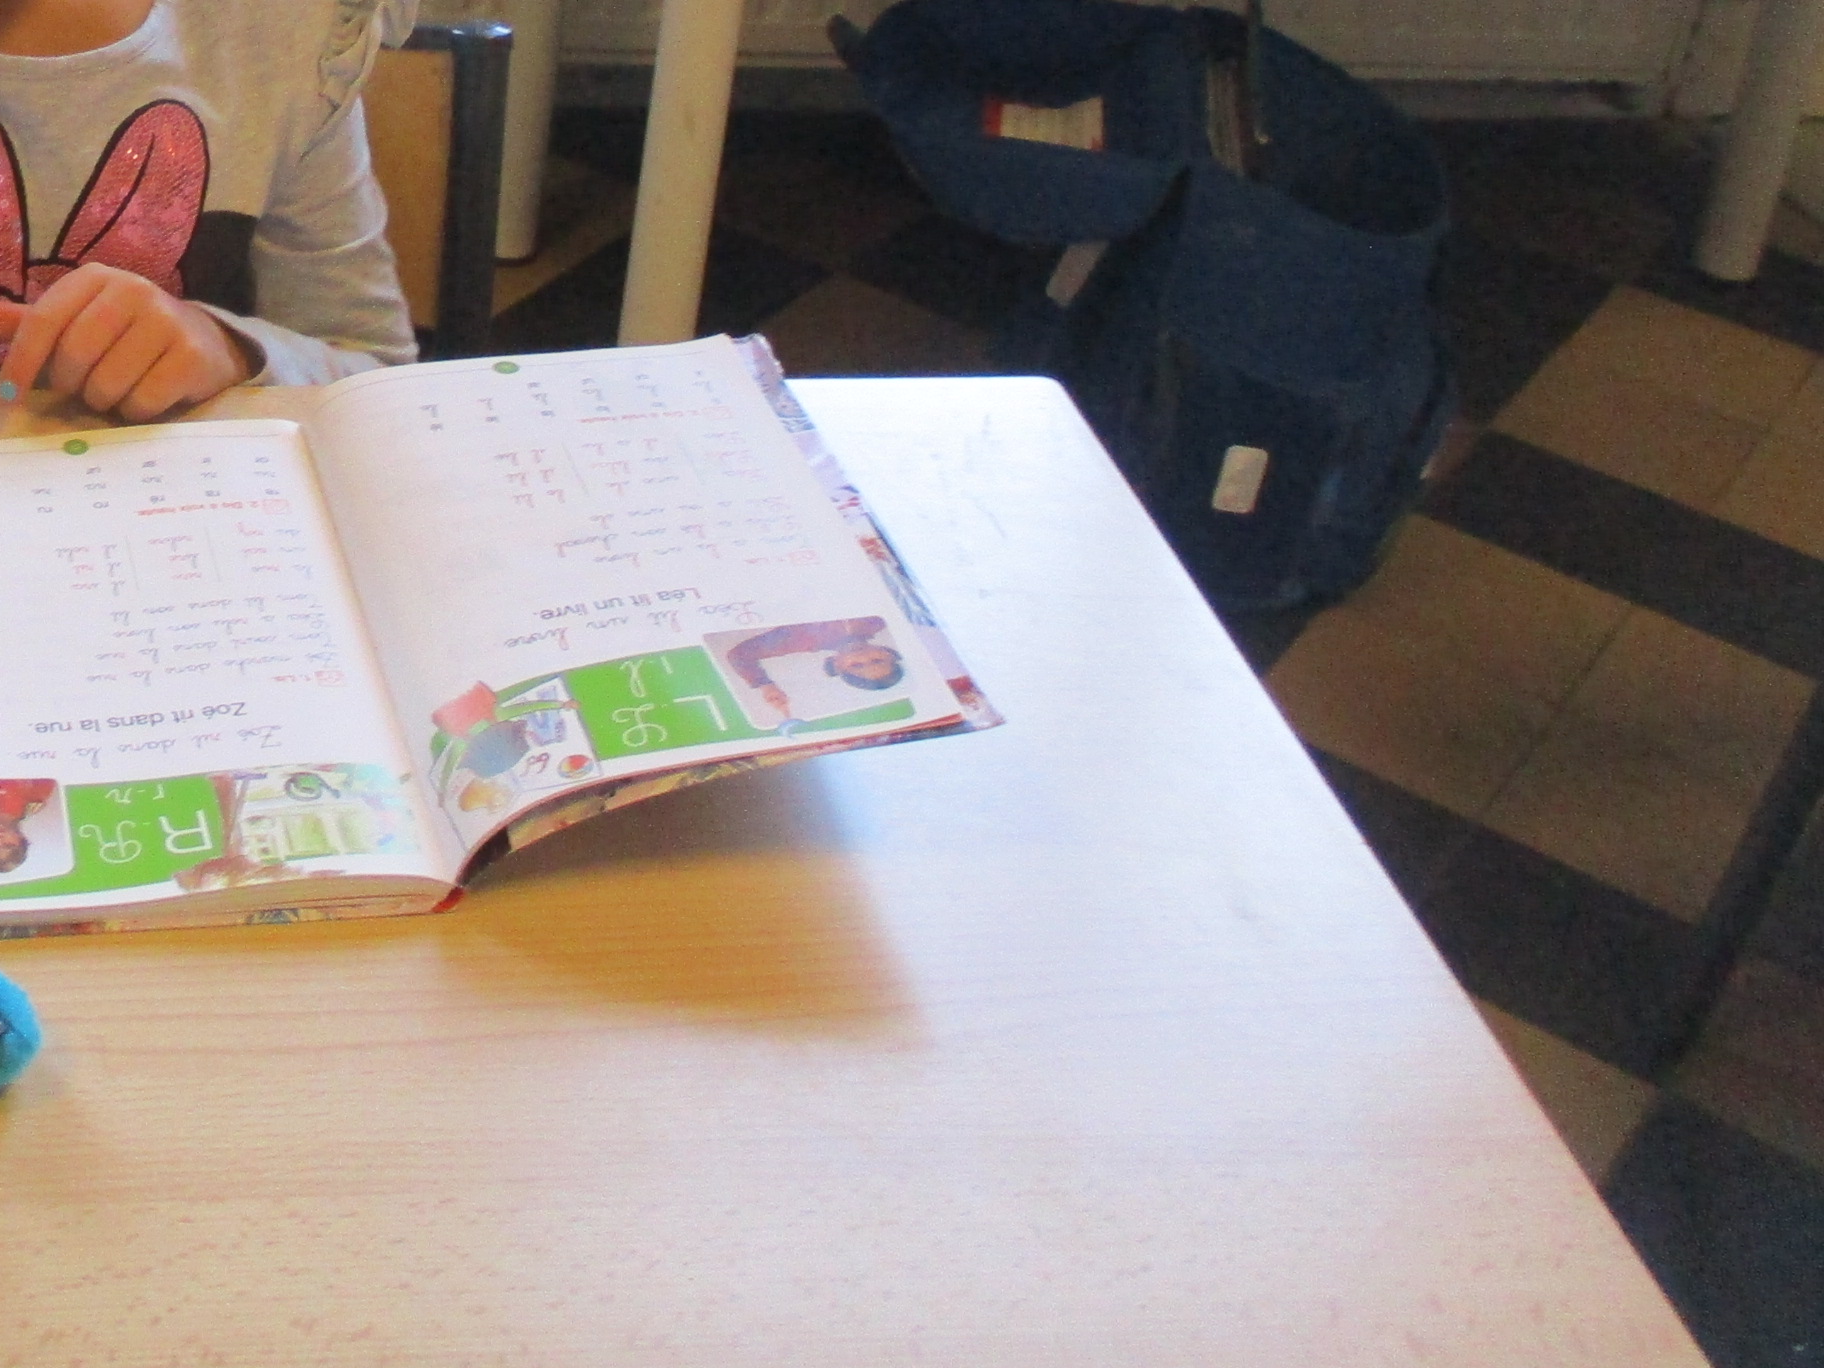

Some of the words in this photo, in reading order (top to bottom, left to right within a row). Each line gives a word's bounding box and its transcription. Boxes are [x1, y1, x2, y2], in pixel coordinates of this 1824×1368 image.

[628, 593, 653, 607] lit
[656, 587, 701, 603] Léa
[532, 603, 589, 621] livre.
[593, 597, 624, 612] un
[172, 708, 195, 724] rit
[201, 701, 247, 721] Zoé
[27, 720, 72, 735] rue.
[78, 718, 100, 733] la
[107, 711, 164, 731] dans
[118, 738, 175, 753] dans
[191, 733, 221, 748] rit
[73, 747, 102, 769] la
